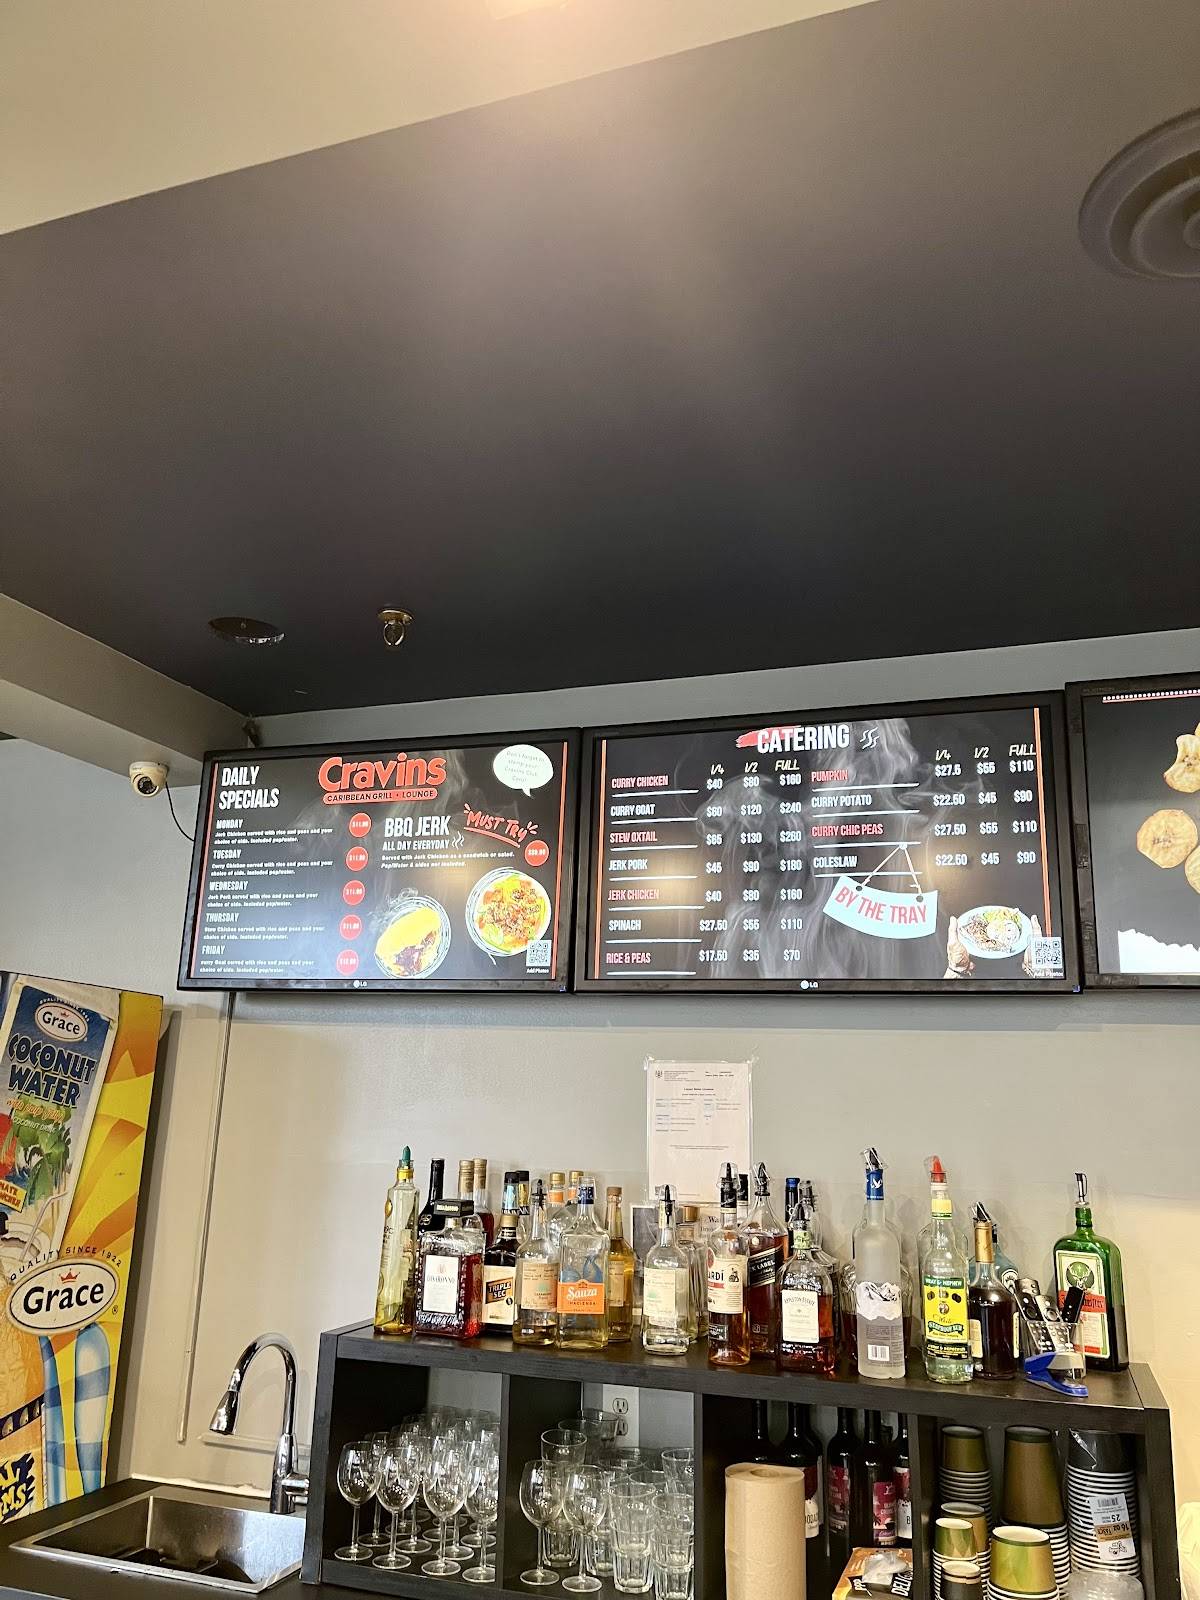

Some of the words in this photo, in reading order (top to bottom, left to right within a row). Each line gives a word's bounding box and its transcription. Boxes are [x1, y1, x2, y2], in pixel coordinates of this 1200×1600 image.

[757, 724, 850, 753] CATERING
[1009, 745, 1036, 756] FULL
[775, 759, 800, 771] FULL
[977, 762, 995, 775] $55
[1010, 760, 1034, 773] $110
[222, 766, 260, 786] DAILY
[319, 752, 447, 792] Cravins
[811, 770, 848, 782] PUMPKIN
[612, 776, 635, 789] CURRY
[637, 775, 668, 787] CHICKEN
[707, 779, 722, 790] $40
[219, 788, 279, 810] SPECIALS
[811, 795, 838, 807] CURRY
[840, 794, 872, 806] POTATO
[933, 794, 965, 806] $22.50
[979, 792, 997, 804] $45
[611, 805, 635, 816] CURRY
[636, 804, 655, 815] GOAT
[741, 804, 762, 815] $120
[780, 802, 801, 814] $240
[216, 819, 243, 829] MONDAY
[384, 817, 413, 838] BBQ
[415, 815, 451, 836] JERK
[466, 811, 504, 830] MUST
[504, 819, 528, 842] TRY
[812, 824, 838, 837] CURRY
[840, 824, 861, 836] CHIC
[862, 824, 883, 835] PEAS
[935, 824, 967, 836] $27.50
[979, 822, 998, 834] $55
[1013, 820, 1037, 833] $110
[610, 832, 631, 843] STEW
[632, 831, 657, 842] OXTAIL
[383, 841, 395, 851] ALL
[397, 841, 411, 850] DAY
[413, 840, 449, 850] EVERYDAY
[213, 849, 241, 859] TUESDAY
[981, 852, 1000, 865] $45
[608, 860, 626, 871] JERK
[628, 859, 647, 870] PORK
[706, 862, 722, 873] $45
[813, 856, 857, 868] COLESLAW
[210, 881, 248, 890] WEDNESDAY
[608, 890, 626, 901] JERK
[628, 889, 659, 900] CHICKEN
[705, 890, 721, 902] $40
[780, 888, 802, 900] $160
[835, 886, 859, 908] BY
[858, 897, 886, 921] THE
[890, 905, 926, 924] TRAY
[206, 913, 239, 922] THURSDAY
[608, 920, 641, 931] SPINACH
[743, 919, 759, 931] $55
[781, 918, 803, 930] $110
[202, 946, 225, 954] FRIDAY
[699, 950, 728, 962] $17.50
[743, 949, 759, 962] $35
[784, 949, 800, 961] $70
[607, 953, 623, 963] RICE
[625, 953, 630, 963] &
[631, 952, 651, 963] PEAS
[42, 1010, 81, 1034] Grace
[8, 1033, 97, 1083] COCONUT
[8, 1065, 81, 1108] WATER
[10, 1249, 60, 1281] QUALITY
[66, 1247, 97, 1255] SINCE
[101, 1249, 122, 1267] 1922
[757, 1260, 776, 1270] LABEL
[489, 1281, 511, 1293] TRIPLE
[567, 1286, 598, 1301] Sauza
[24, 1282, 104, 1315] Grace
[494, 1290, 506, 1298] SEC
[1111, 1514, 1120, 1522] 25
